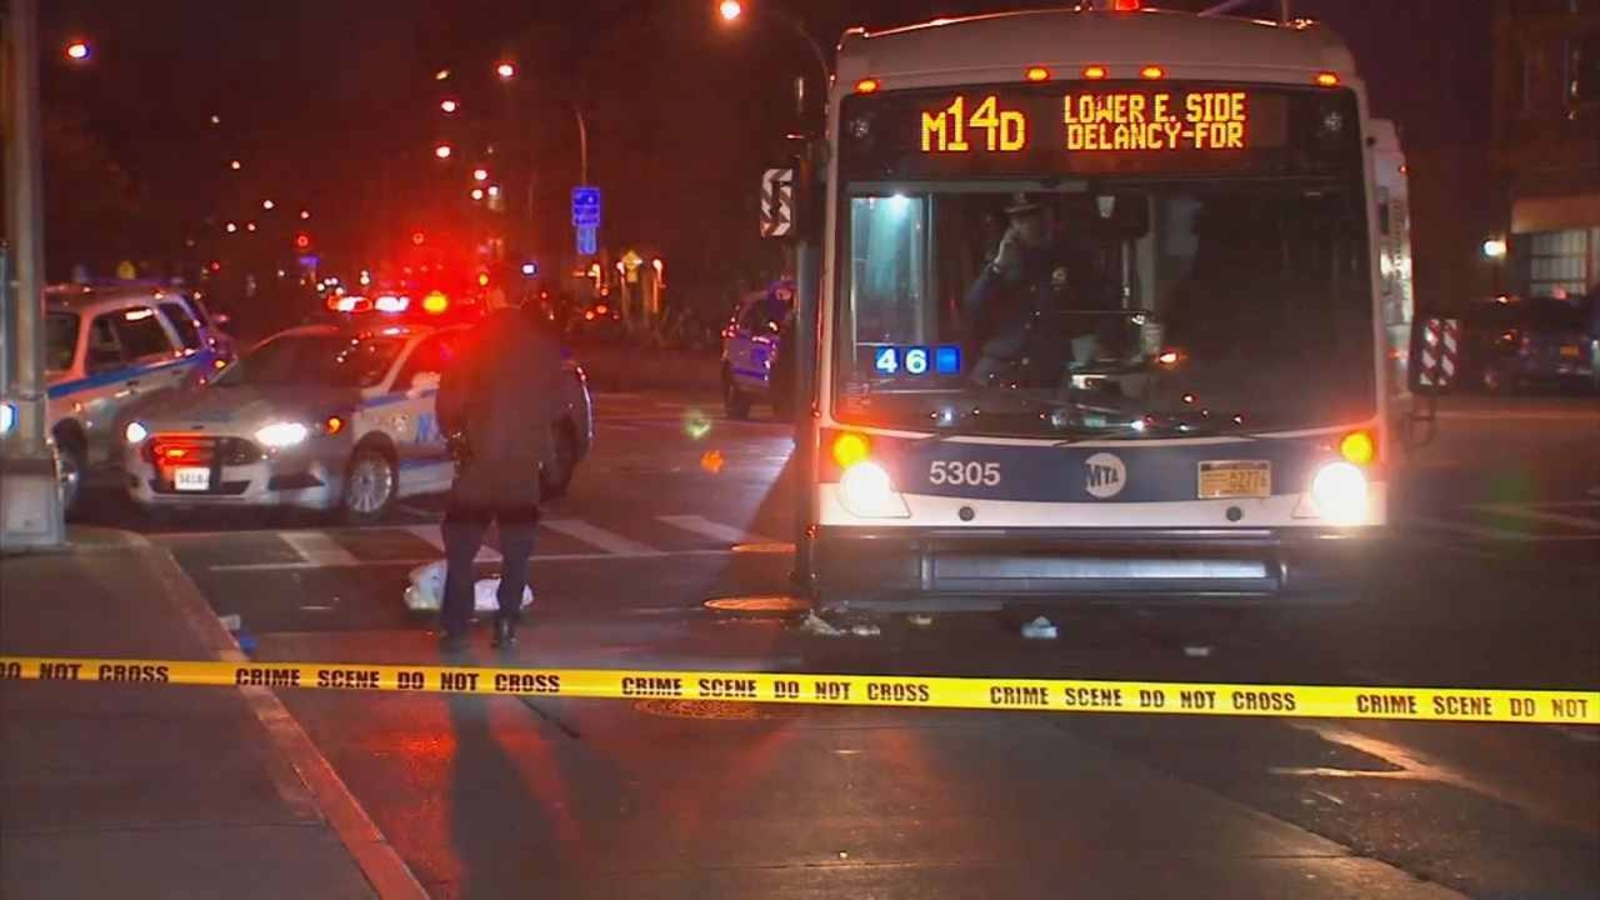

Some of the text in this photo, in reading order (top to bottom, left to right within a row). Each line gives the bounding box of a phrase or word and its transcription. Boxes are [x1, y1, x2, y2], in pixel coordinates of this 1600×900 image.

[1064, 92, 1246, 124] LOWER E. SIDE
[921, 96, 1025, 151] M14D
[1067, 122, 1244, 150] DELANCY-FDR
[929, 460, 1001, 486] 5305
[1083, 463, 1120, 487] MTA
[40, 663, 81, 680] NOT
[99, 664, 169, 682] CROSS
[235, 668, 300, 687] CRIME
[317, 669, 380, 689] SCENE
[397, 671, 424, 690] DO
[441, 672, 480, 691] NOT
[495, 673, 560, 693] CROSS
[621, 676, 683, 696] CRIME
[699, 678, 757, 697] SCENE
[774, 680, 800, 699] DO
[815, 681, 851, 700] NOT
[867, 682, 930, 702] CROSS
[990, 686, 1049, 706] CRIME
[1065, 687, 1123, 707] SCENE
[1139, 689, 1165, 708] DO
[1180, 690, 1217, 709] NOT
[1232, 691, 1296, 712] CROSS
[1356, 694, 1417, 714] CRIME
[1432, 696, 1493, 716] SCENE
[1509, 698, 1536, 717] DO
[1552, 699, 1589, 718] NOT
